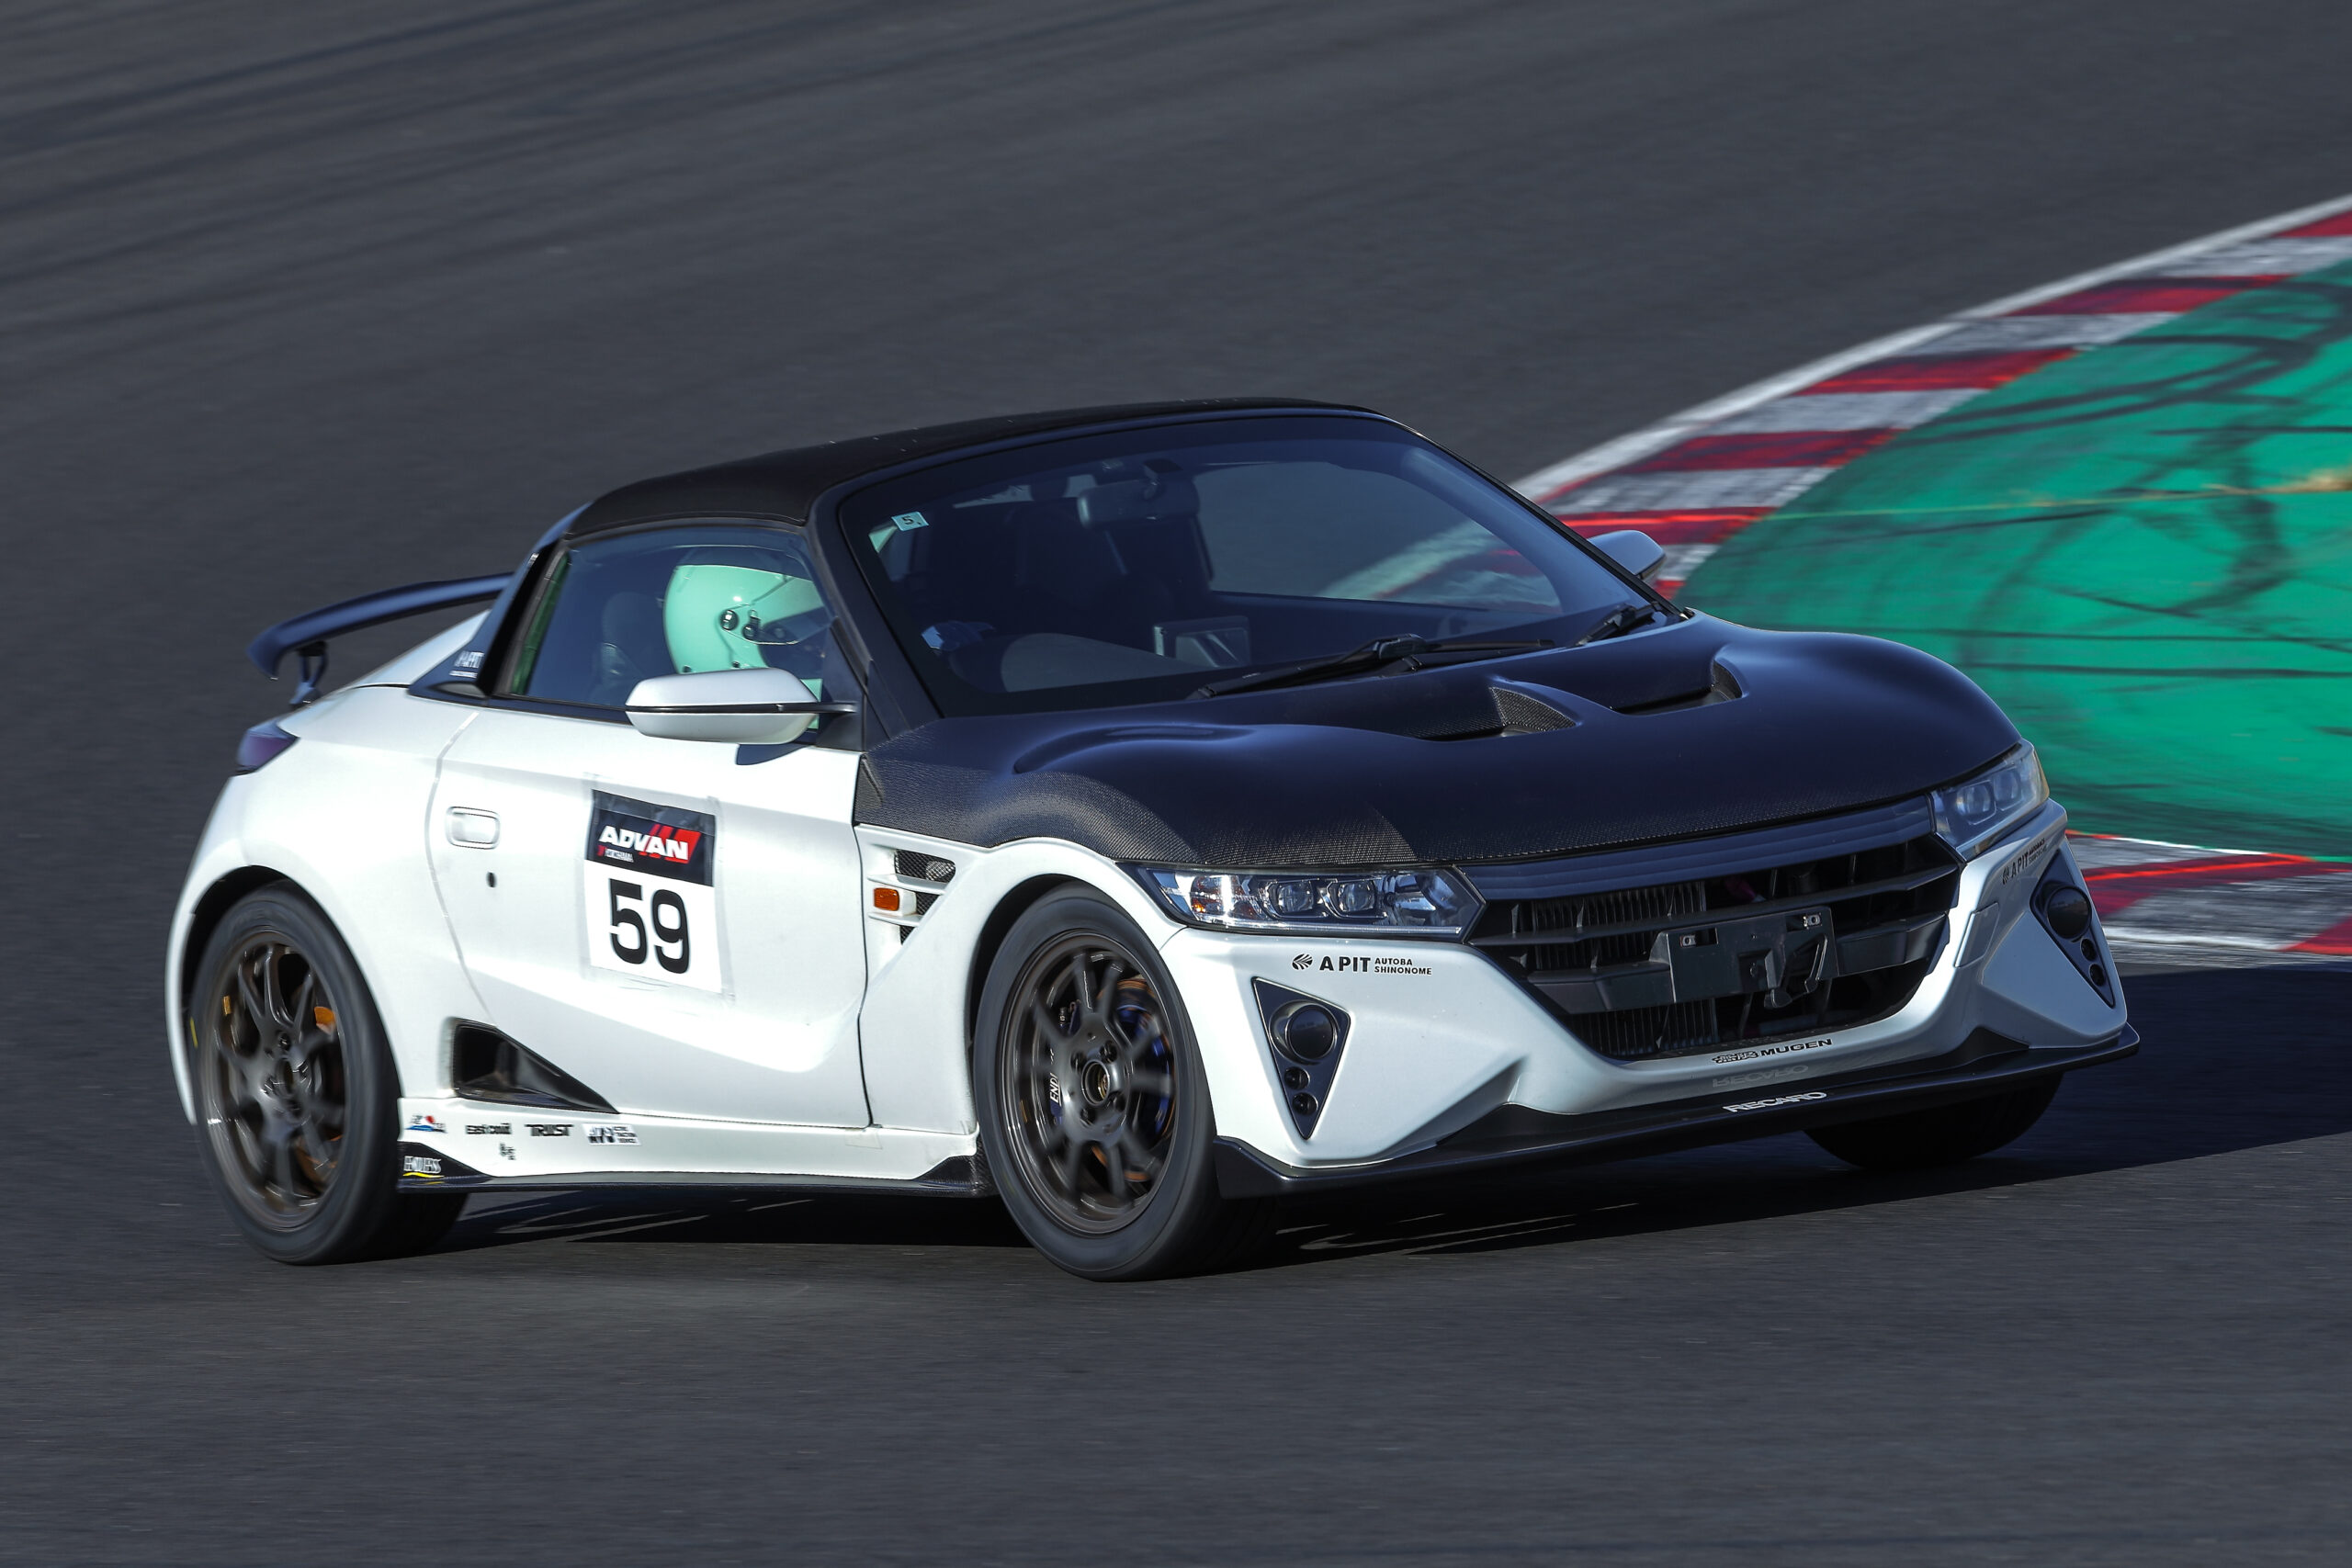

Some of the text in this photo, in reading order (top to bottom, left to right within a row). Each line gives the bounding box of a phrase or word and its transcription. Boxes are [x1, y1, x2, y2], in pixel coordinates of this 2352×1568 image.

[599, 825, 689, 861] ADVAN
[608, 878, 690, 975] 59
[1374, 957, 1413, 966] AUTOBA
[1374, 965, 1432, 976] SHINONOME
[1760, 1038, 1833, 1056] MUGEN
[1722, 1091, 1827, 1113] RECARO
[525, 1123, 574, 1137] TRUST
